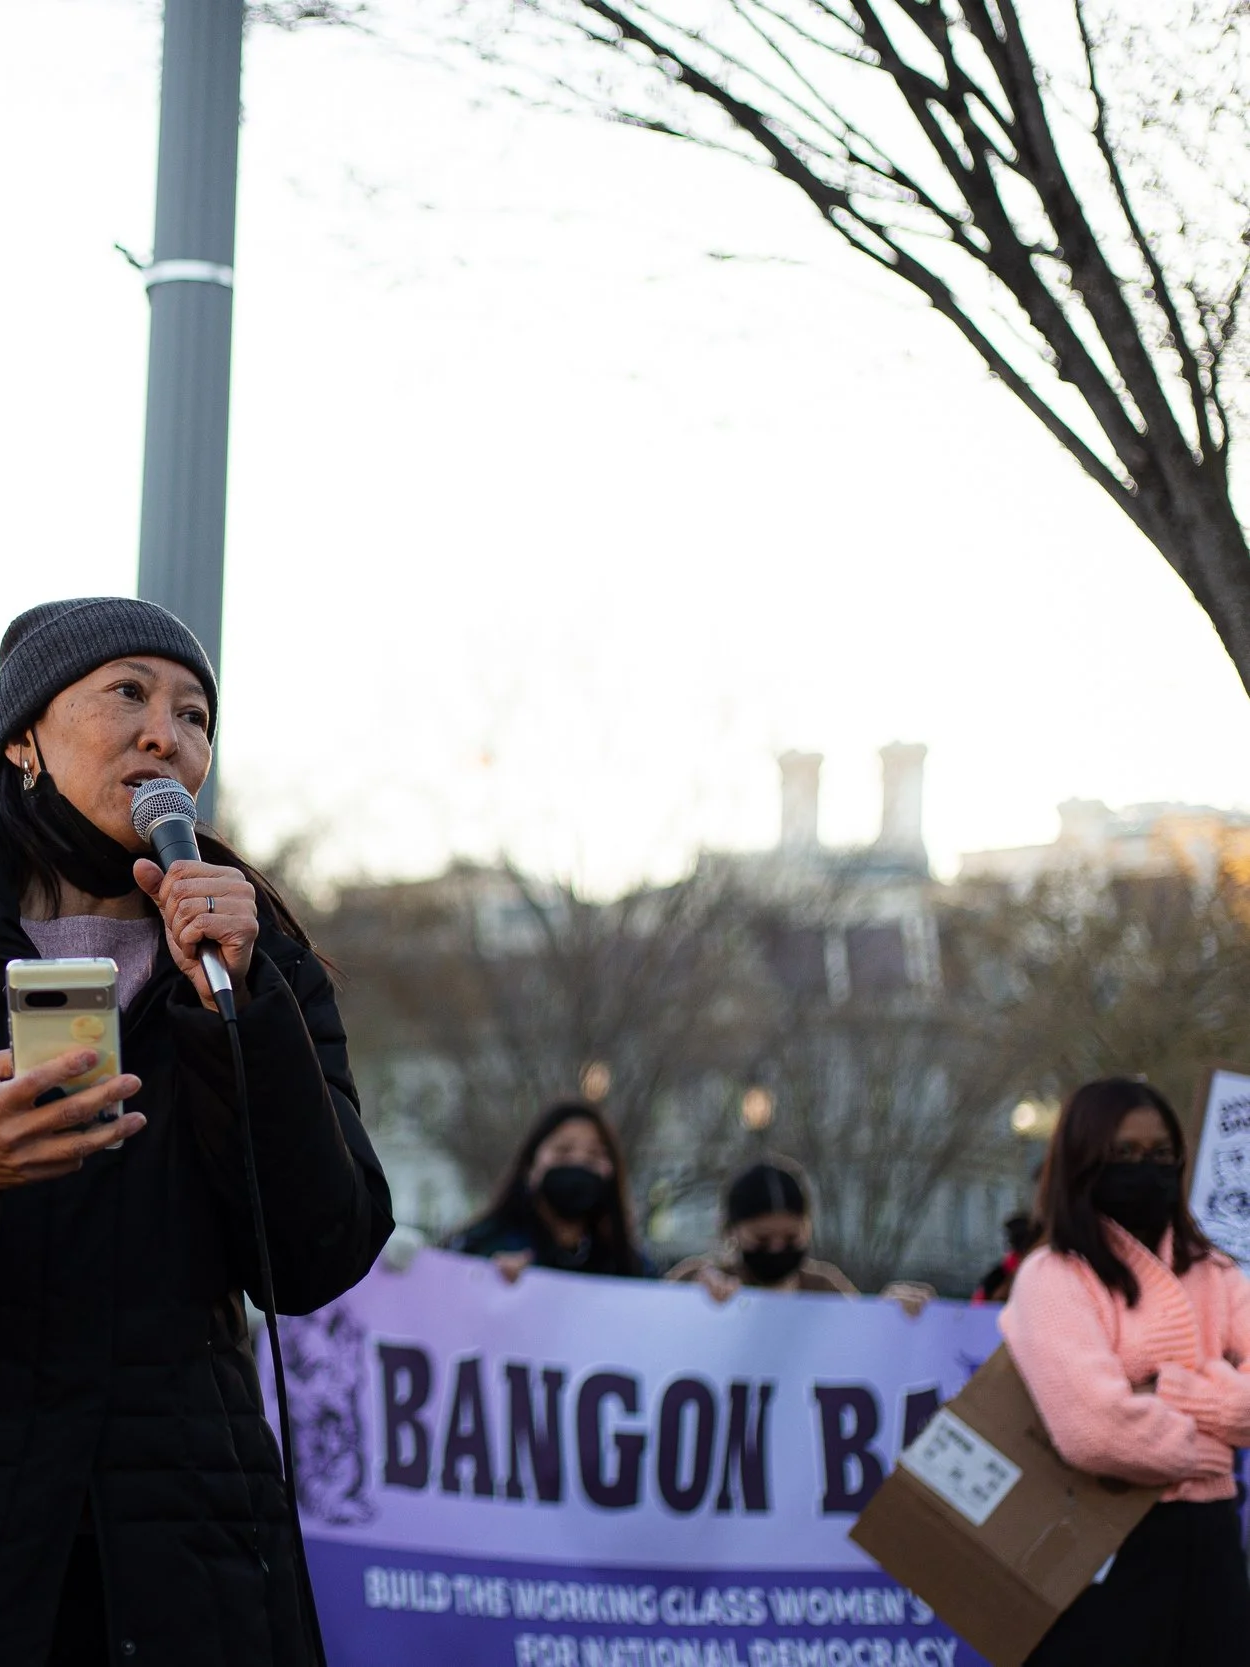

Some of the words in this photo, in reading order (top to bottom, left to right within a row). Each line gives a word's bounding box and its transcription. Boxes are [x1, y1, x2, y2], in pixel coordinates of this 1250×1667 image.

[377, 1342, 774, 1516] BANGON
[363, 1566, 450, 1613] BUILD
[451, 1573, 510, 1618] THE
[510, 1578, 657, 1625] WORKING
[660, 1586, 768, 1626] CLASS
[513, 1633, 578, 1667] FOR
[580, 1635, 748, 1667] NATIONAL
[748, 1637, 957, 1667] DEMOCRACY
